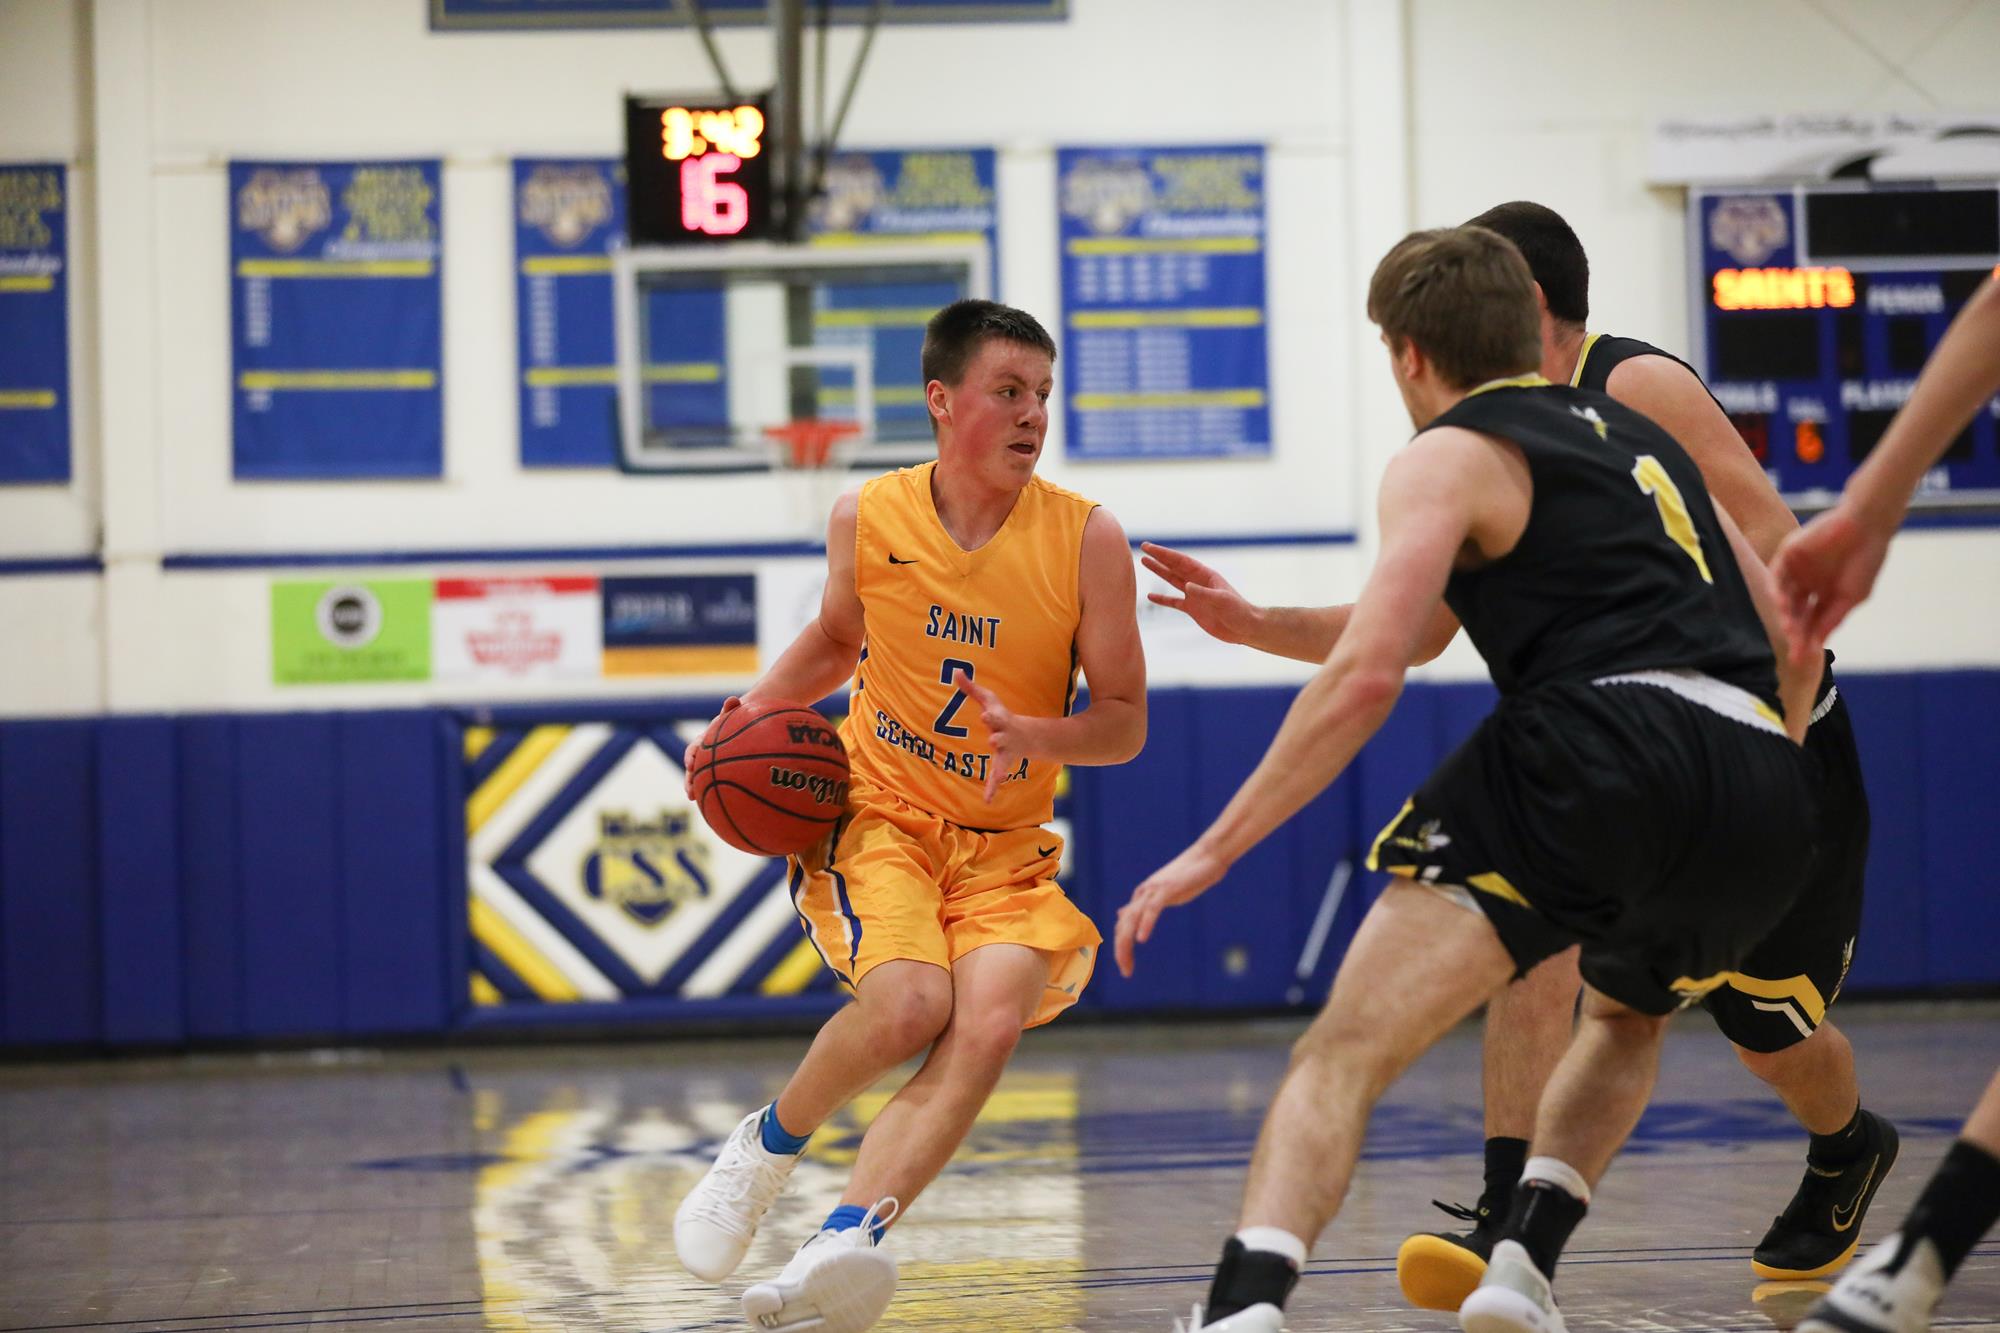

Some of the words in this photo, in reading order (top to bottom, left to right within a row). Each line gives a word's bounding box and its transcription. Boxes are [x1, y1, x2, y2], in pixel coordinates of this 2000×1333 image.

[661, 105, 764, 160] 3:42
[680, 152, 748, 235] 16
[1713, 266, 1855, 310] SAINTS
[1630, 454, 1714, 585] 1
[925, 604, 1001, 649] SAINT
[932, 657, 975, 739] 2
[876, 709, 1029, 781] SCHOLASTA
